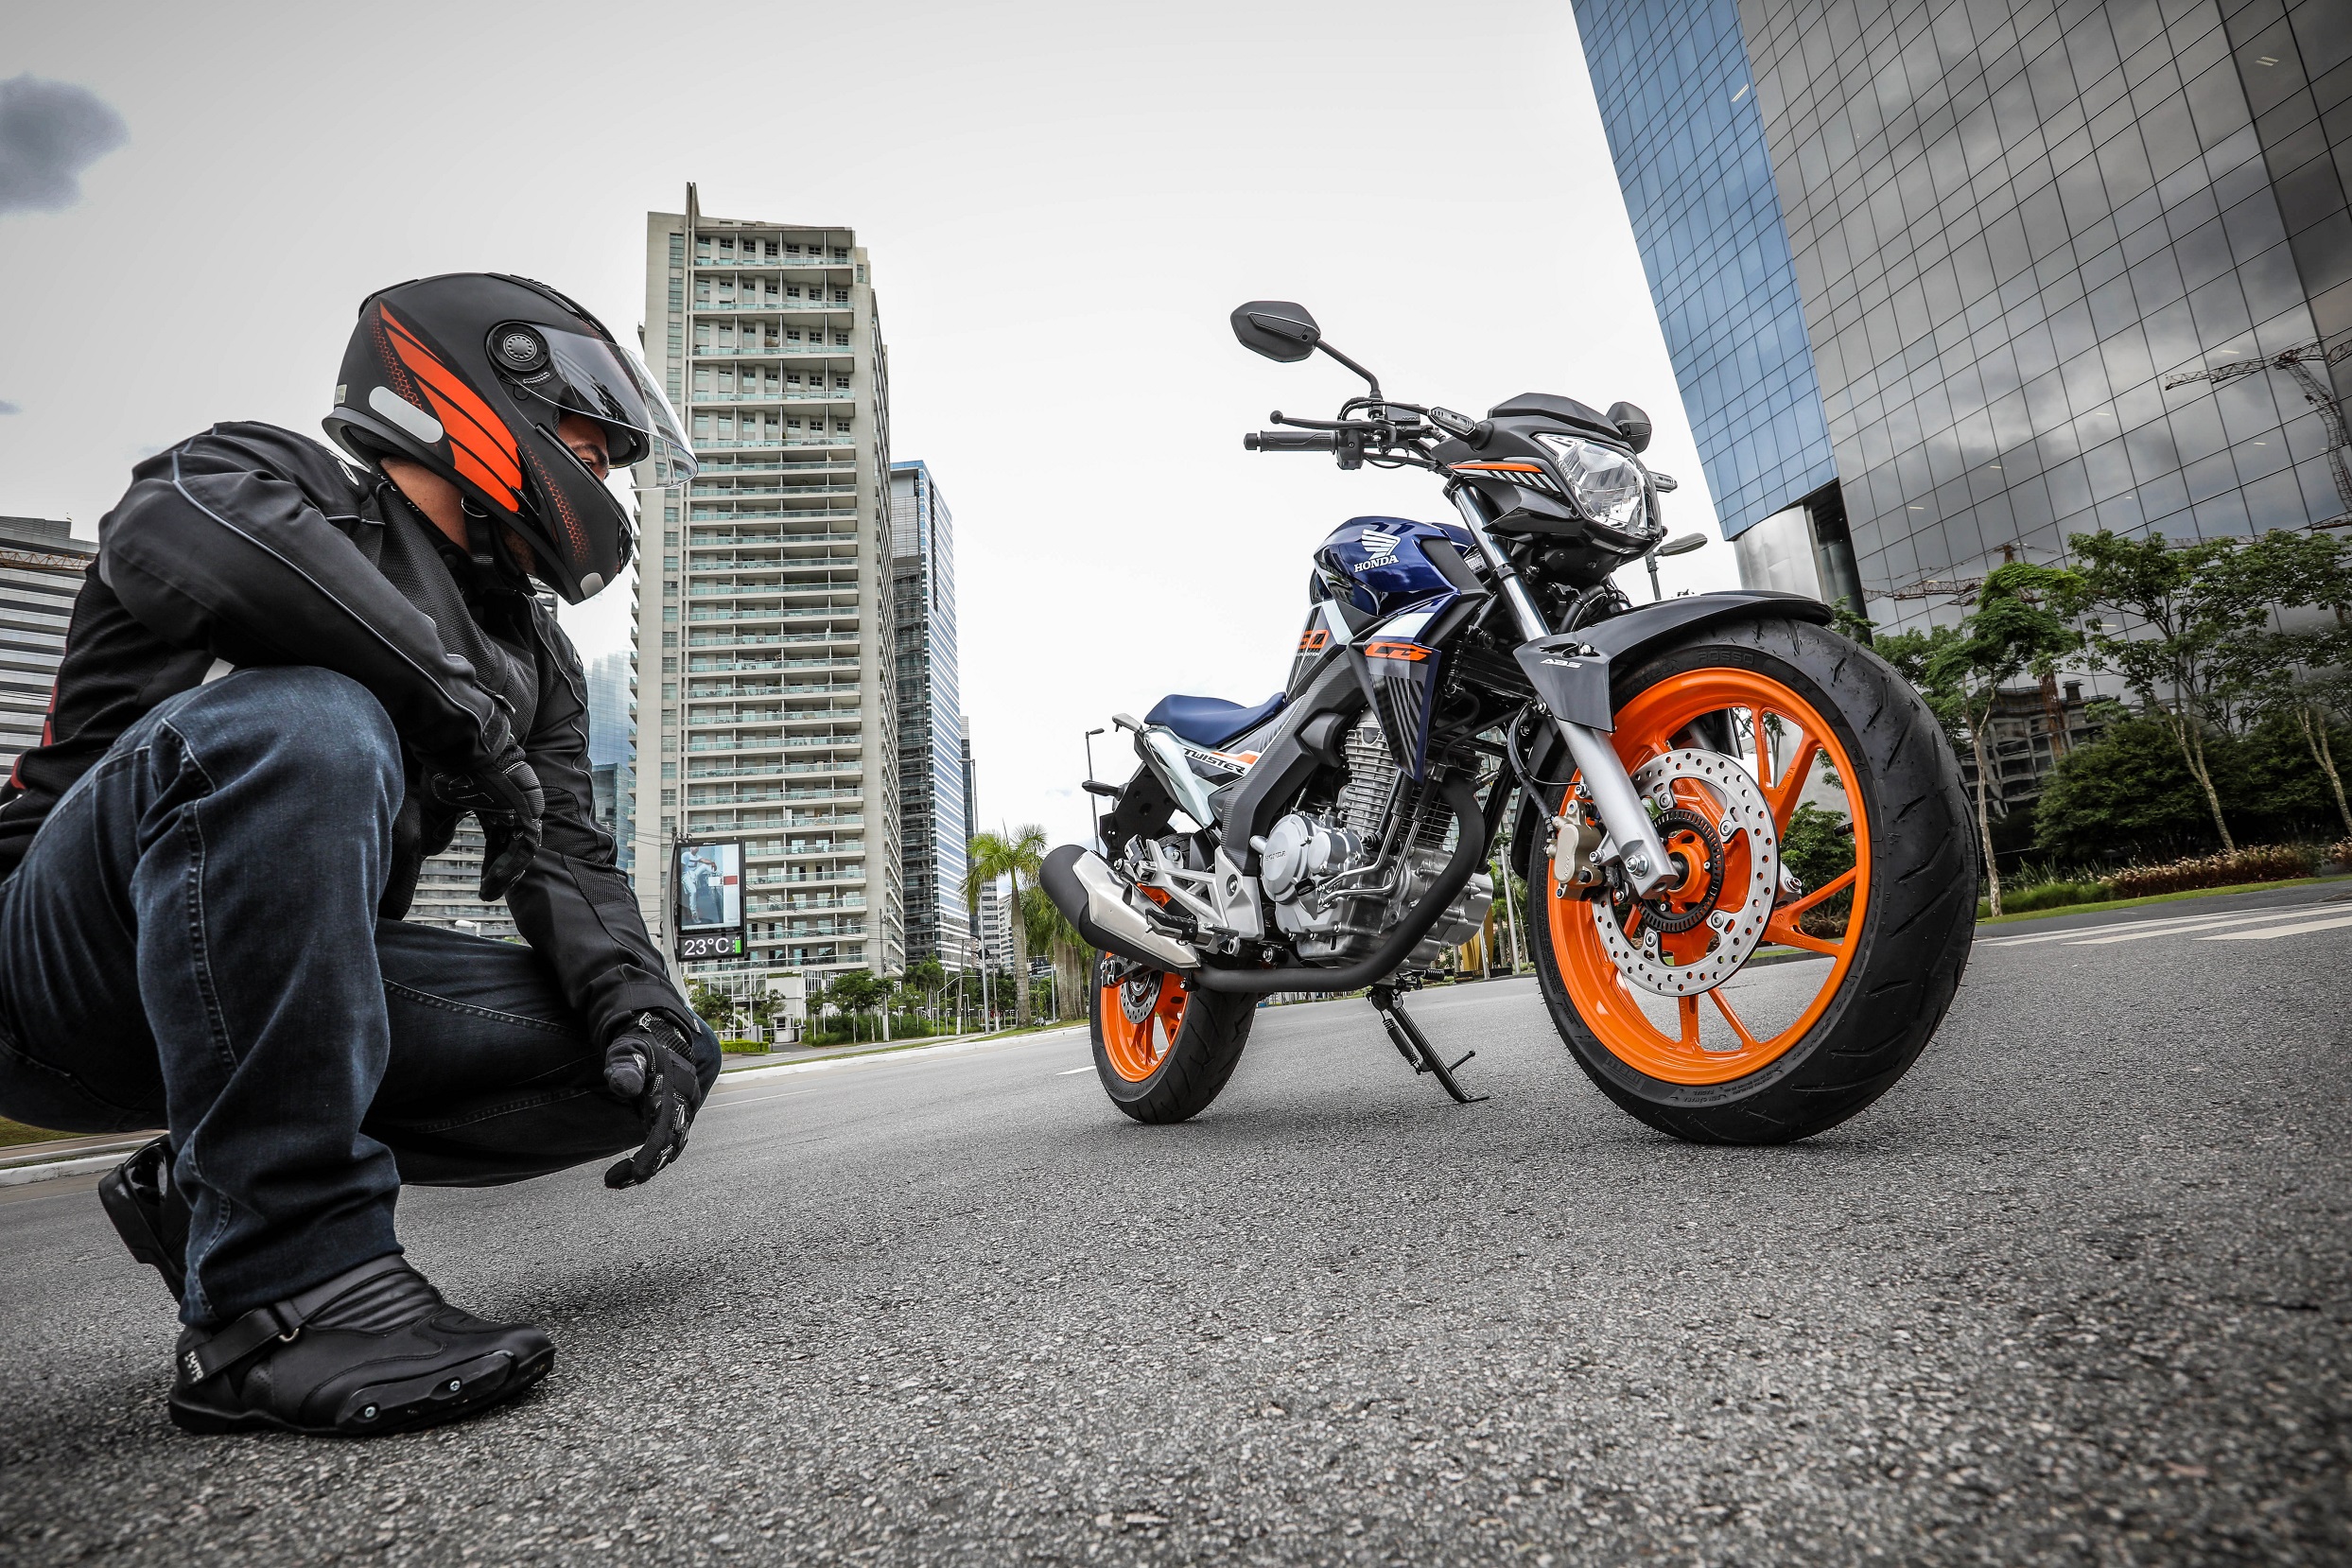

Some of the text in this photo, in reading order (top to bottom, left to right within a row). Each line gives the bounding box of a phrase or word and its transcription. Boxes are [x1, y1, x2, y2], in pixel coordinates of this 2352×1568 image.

[1353, 554, 1400, 573] HONDA
[1364, 641, 1433, 661] CB
[1697, 650, 1755, 666] ROSSO
[1540, 658, 1583, 669] ABS
[1183, 747, 1246, 775] TWISTER
[684, 937, 729, 956] 23°C
[1601, 1056, 1646, 1091] PIRELLI
